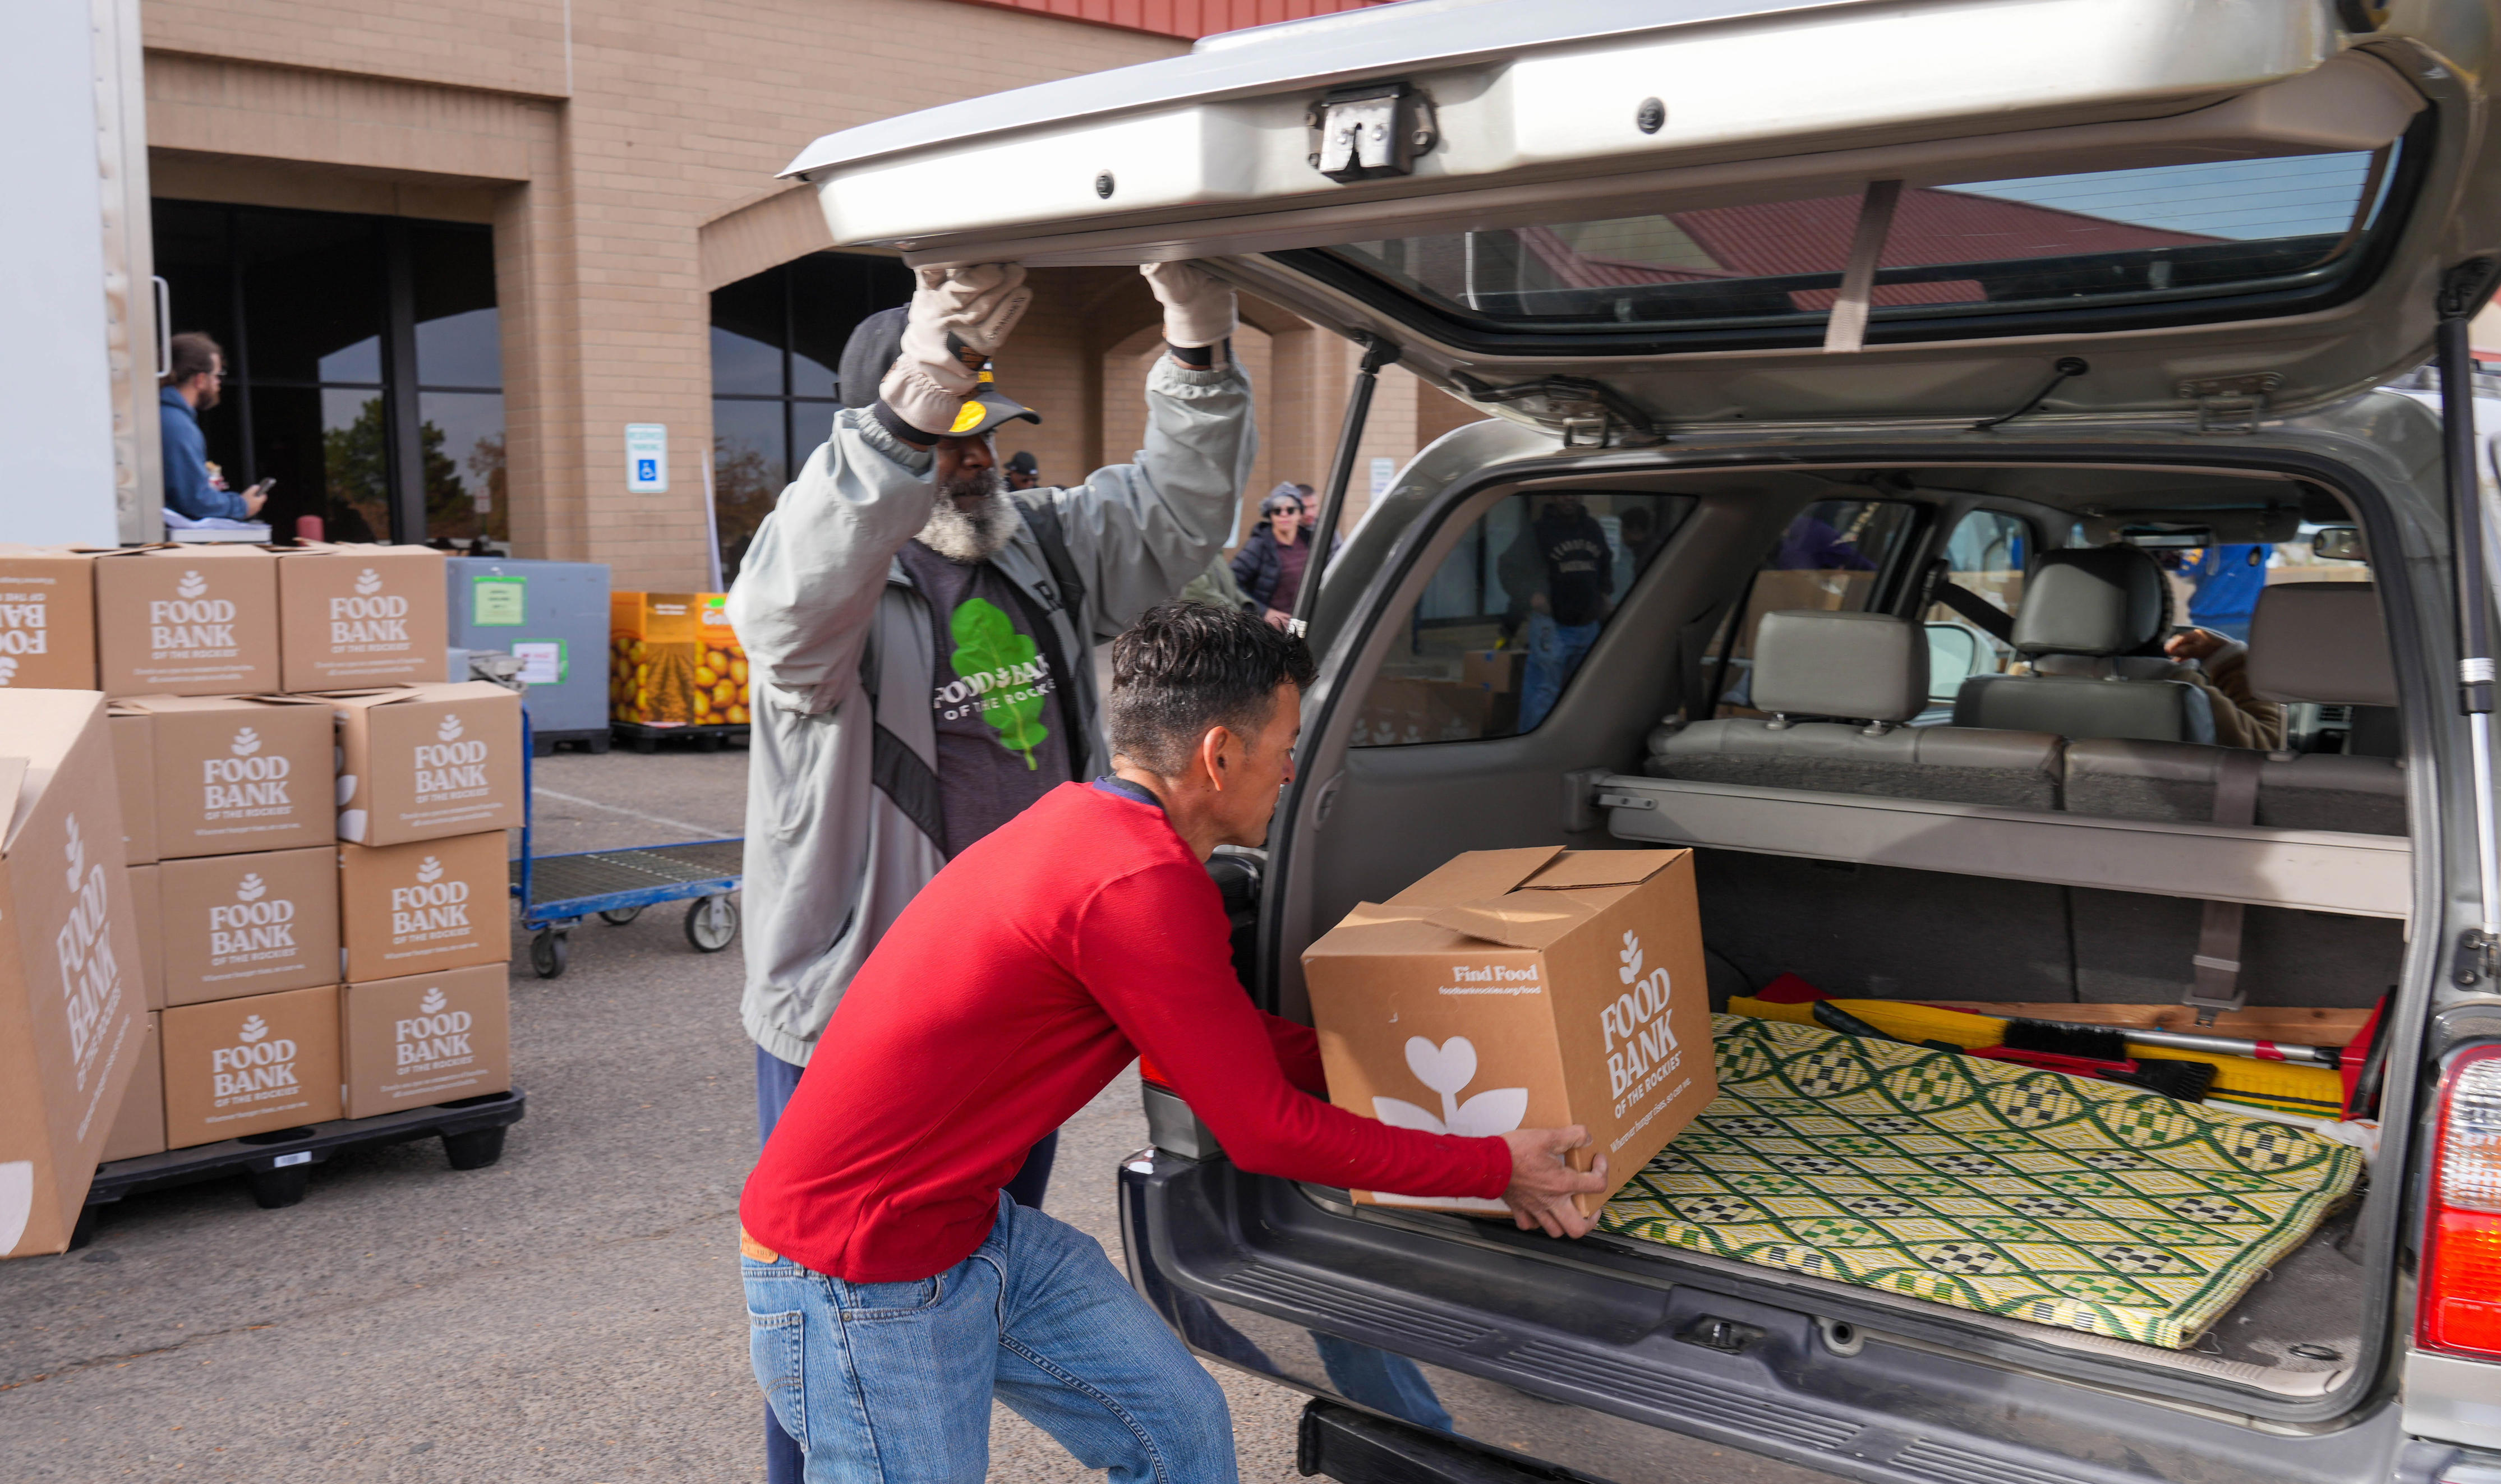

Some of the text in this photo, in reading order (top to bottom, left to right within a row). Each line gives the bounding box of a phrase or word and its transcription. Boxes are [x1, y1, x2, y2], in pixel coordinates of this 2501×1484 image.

[0, 604, 47, 628] BA
[150, 600, 236, 624] FOOD
[329, 596, 408, 619] FOOD
[0, 630, 48, 654] FO
[151, 624, 237, 648] BANK
[330, 619, 409, 643] BANK
[944, 705, 970, 720] OF
[973, 698, 1001, 712] THE
[203, 755, 290, 784] FOOD
[414, 740, 487, 769] FOOD
[415, 764, 488, 793] BANK
[204, 781, 291, 809] BANK
[391, 881, 469, 911] FOOD
[209, 900, 294, 930] FOOD
[392, 904, 470, 935] BANK
[57, 864, 107, 999] FOOD
[211, 924, 296, 955] BANK
[1452, 964, 1539, 982] Find Food
[67, 919, 118, 1066] BANK
[1600, 967, 1671, 1054] FOOD
[395, 1011, 472, 1042] FOOD
[212, 1039, 297, 1073] FOOD
[396, 1033, 472, 1066] BANK
[1607, 1008, 1678, 1100] BANK
[213, 1062, 298, 1098] BANK
[1615, 1054, 1681, 1119] OF THE ROCKIES
[1610, 1126, 1635, 1153] Wherever
[1635, 1112, 1653, 1132] hunger
[1666, 1093, 1673, 1103] so
[1674, 1086, 1683, 1098] can
